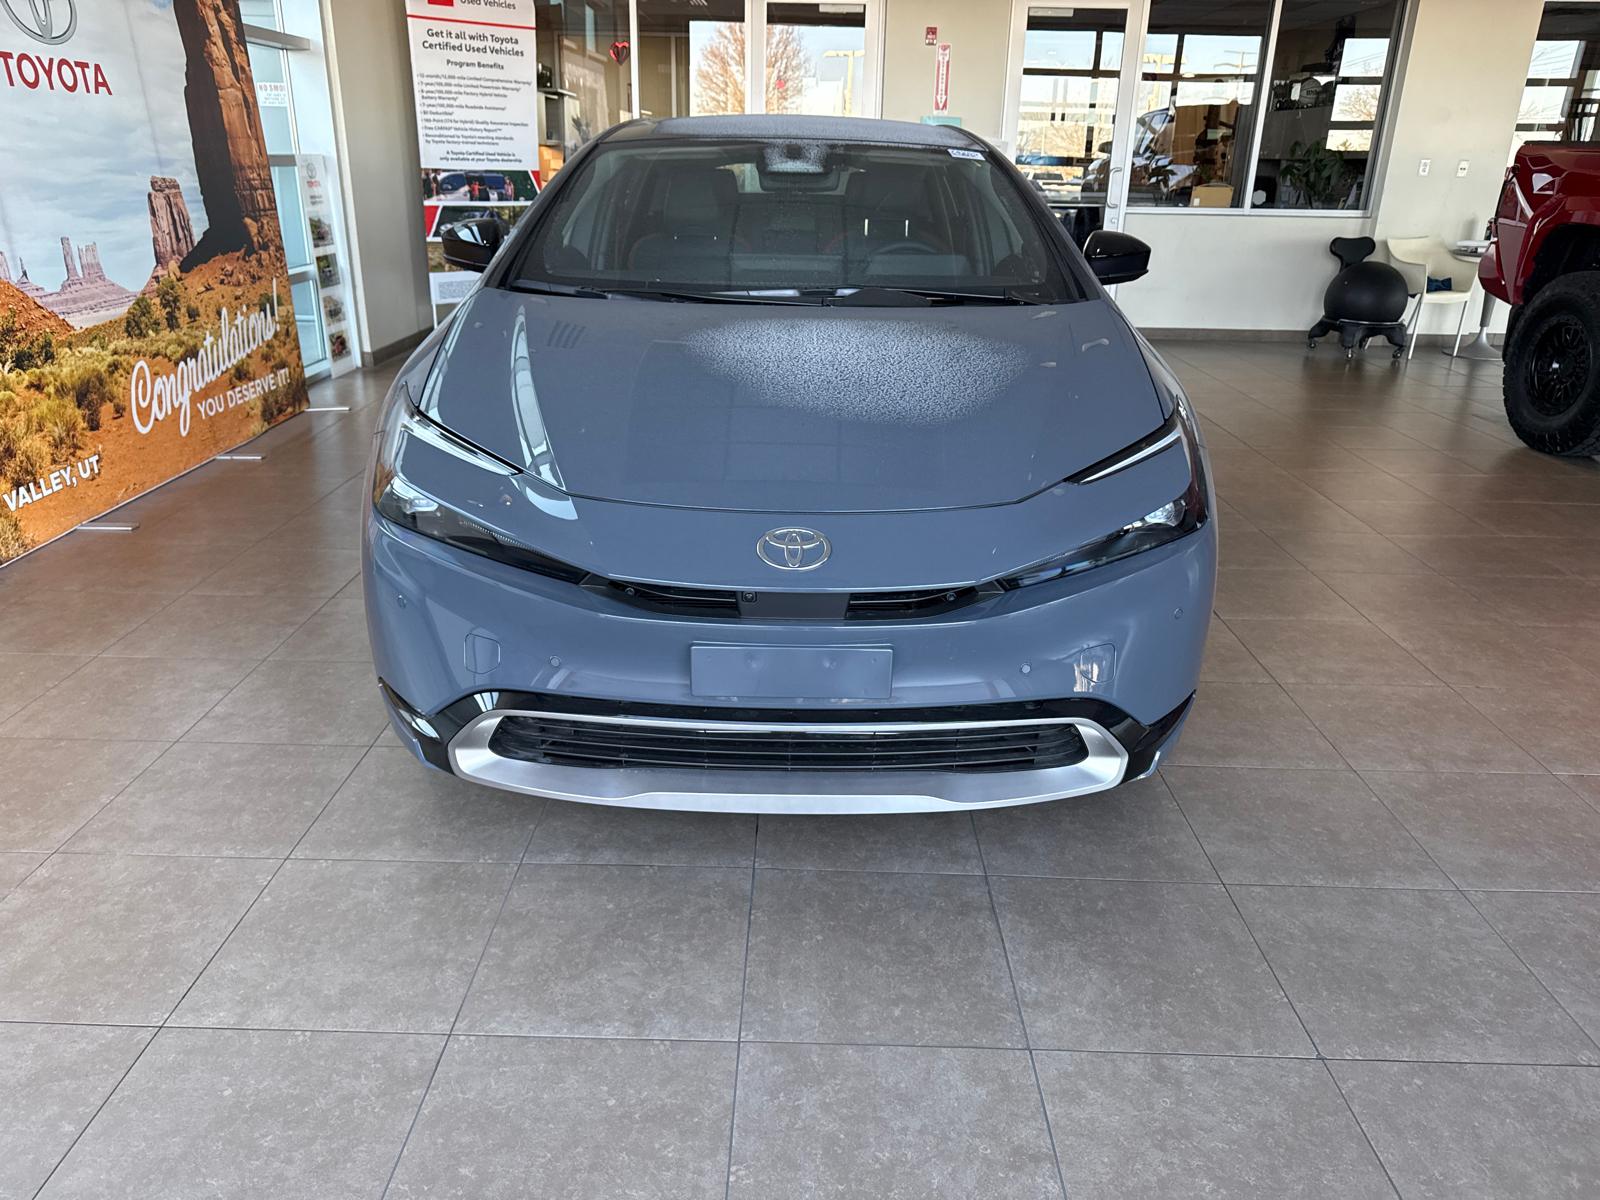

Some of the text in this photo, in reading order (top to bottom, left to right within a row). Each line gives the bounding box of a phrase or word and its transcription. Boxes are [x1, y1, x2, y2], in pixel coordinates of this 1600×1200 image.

[483, 0, 516, 10] Vehicles
[422, 40, 524, 58] Certified Used Vehicles
[426, 28, 519, 46] Get it all with Toyota
[0, 51, 113, 96] TOYOTA
[446, 59, 504, 70] Program Benefits
[131, 277, 280, 437] Congratulations!
[196, 366, 290, 420] YOU DESERVE IT!
[2, 454, 100, 512] VALLEY, UT
